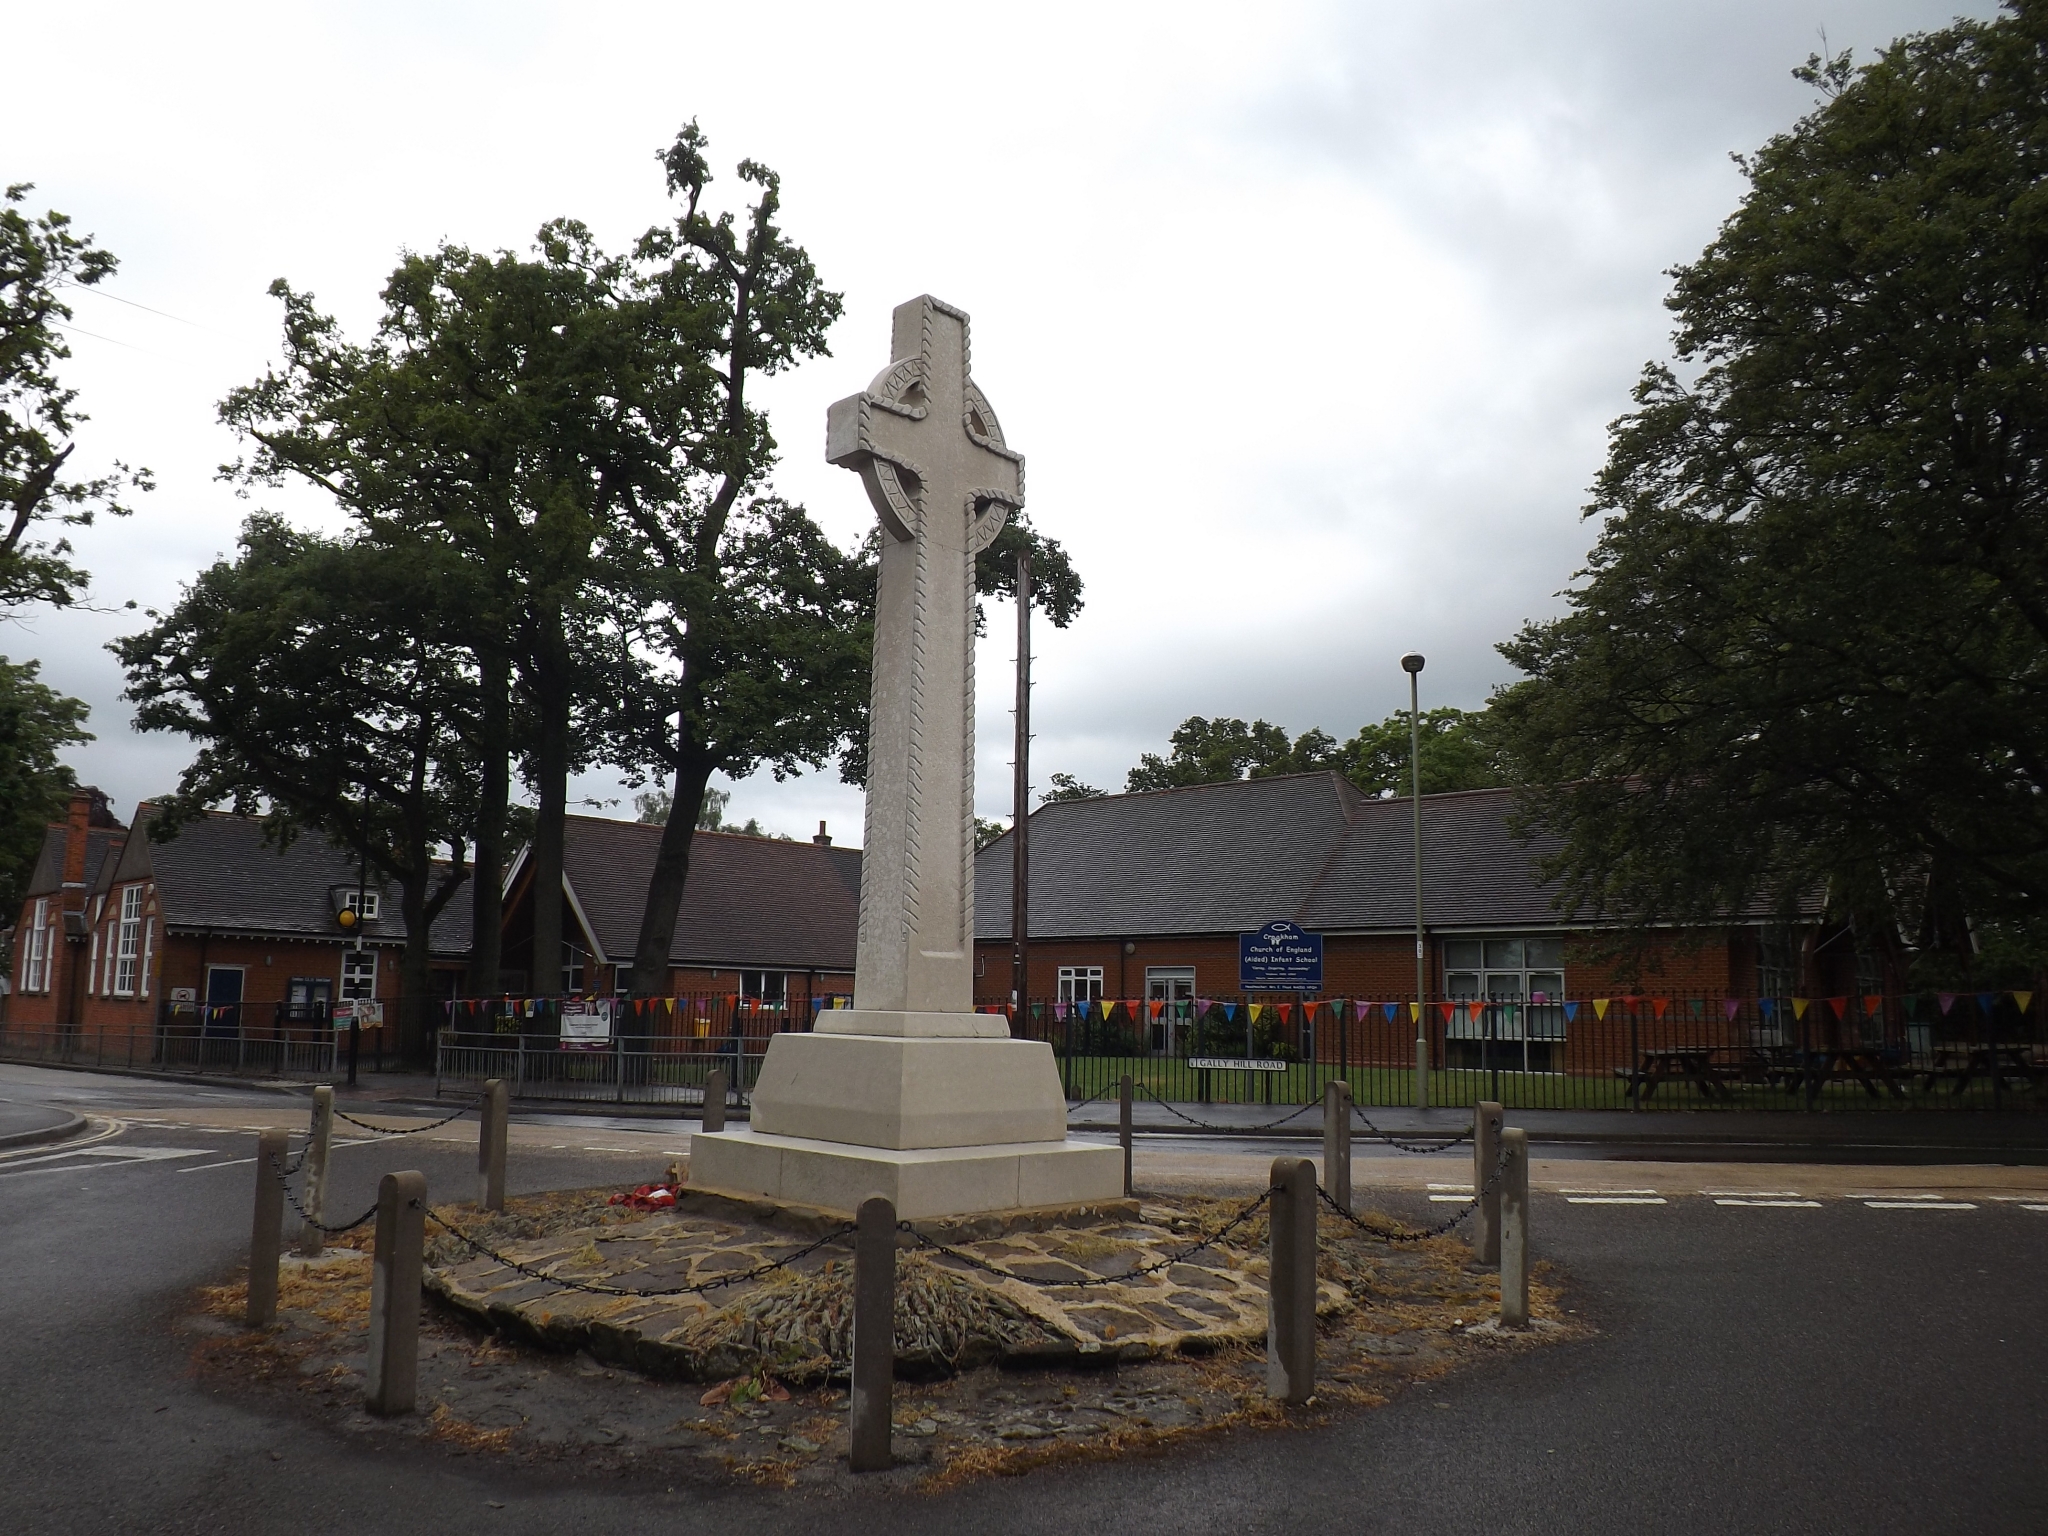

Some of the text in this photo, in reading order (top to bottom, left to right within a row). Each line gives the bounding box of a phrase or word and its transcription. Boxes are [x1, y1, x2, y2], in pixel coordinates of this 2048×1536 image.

[1286, 946, 1312, 954] England
[1199, 1059, 1283, 1070] GALLY HILL ROAD
